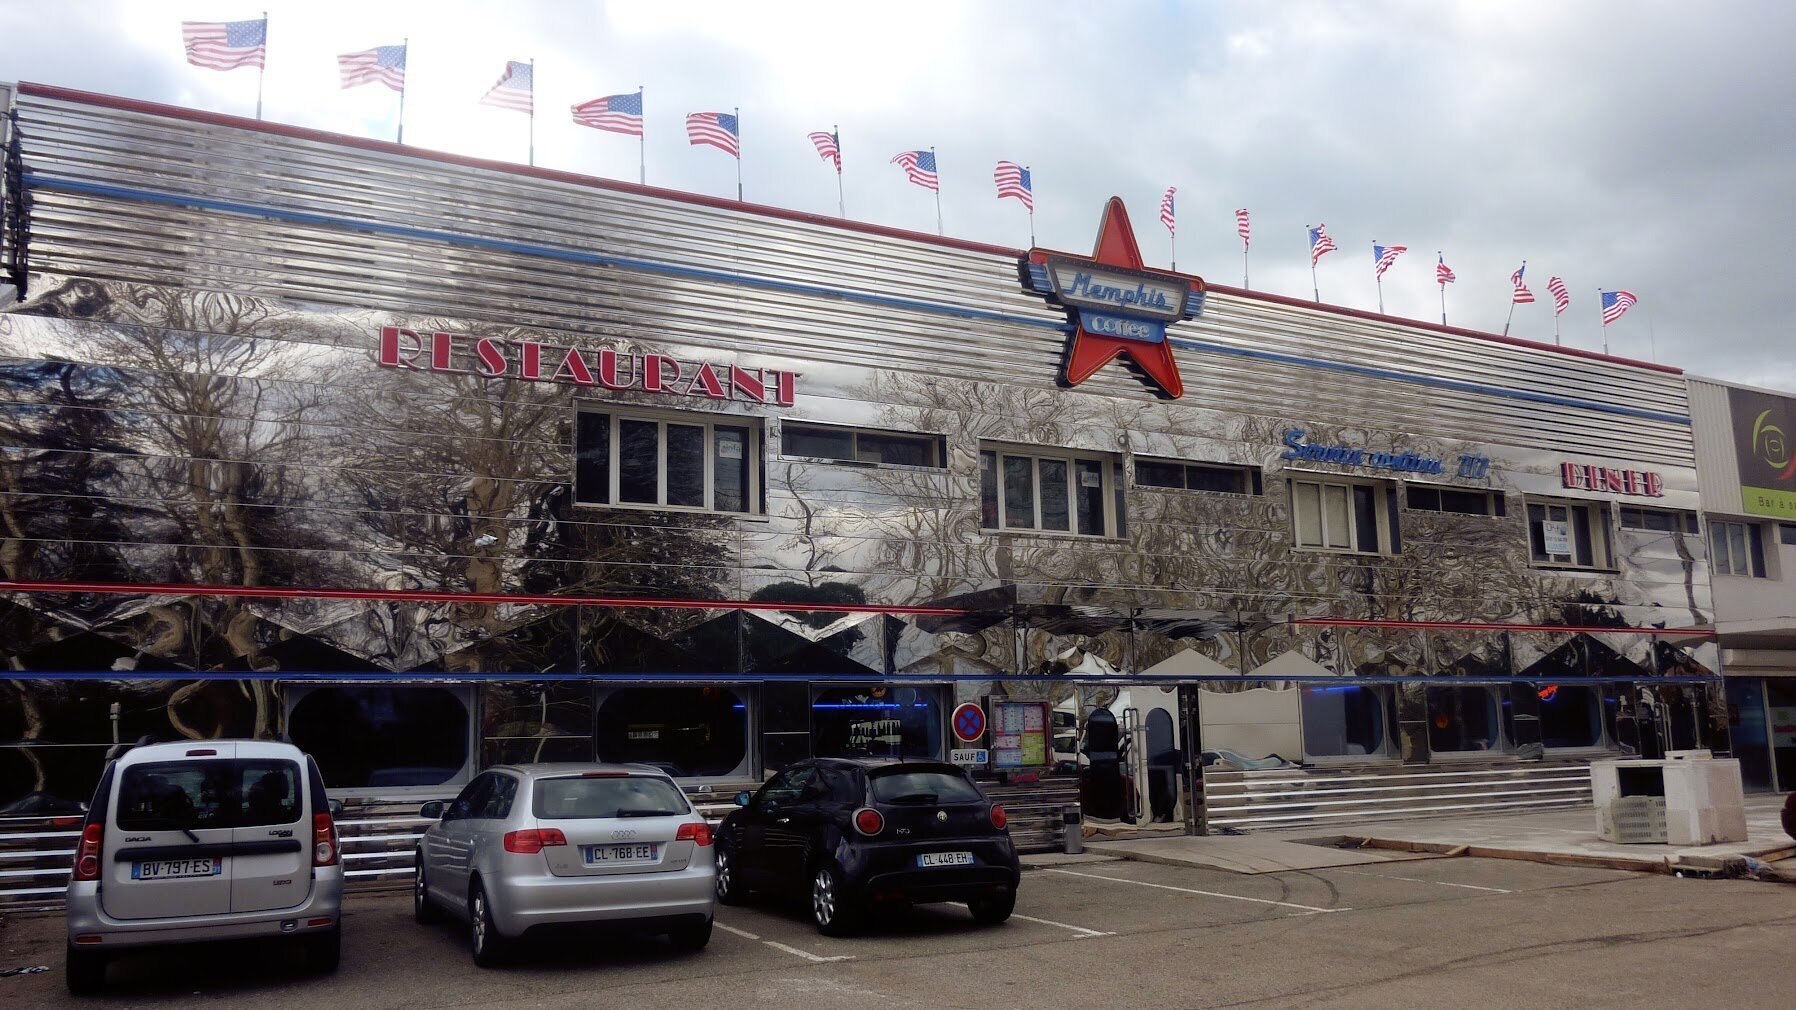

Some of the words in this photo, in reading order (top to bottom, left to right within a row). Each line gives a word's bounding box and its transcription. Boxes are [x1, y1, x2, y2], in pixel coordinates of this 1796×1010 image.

[1064, 272, 1175, 309] Memphis
[1091, 316, 1151, 338] Coffee
[379, 325, 801, 407] RESTAURANT
[1561, 462, 1664, 497] DINER
[953, 753, 976, 761] SAUF
[142, 860, 210, 876] BV-797-ES
